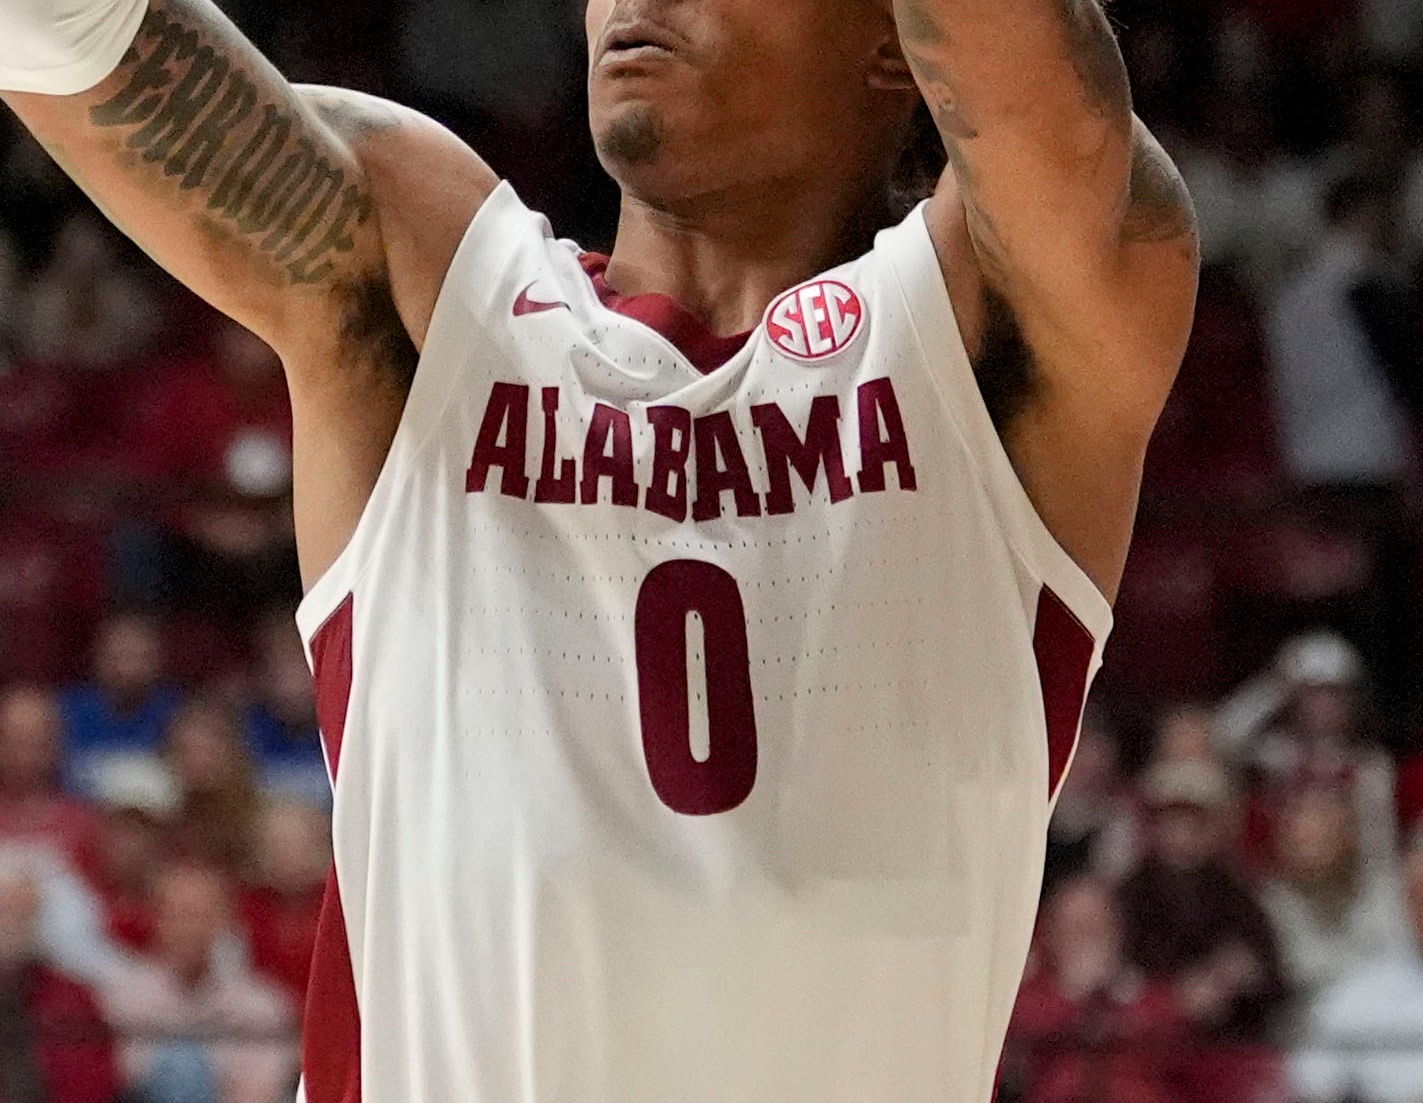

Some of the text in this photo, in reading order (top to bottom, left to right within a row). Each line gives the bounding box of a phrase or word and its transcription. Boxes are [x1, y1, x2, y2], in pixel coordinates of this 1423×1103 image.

[770, 282, 858, 356] SEC
[465, 376, 917, 523] ALABAMA
[634, 558, 758, 817] 0
